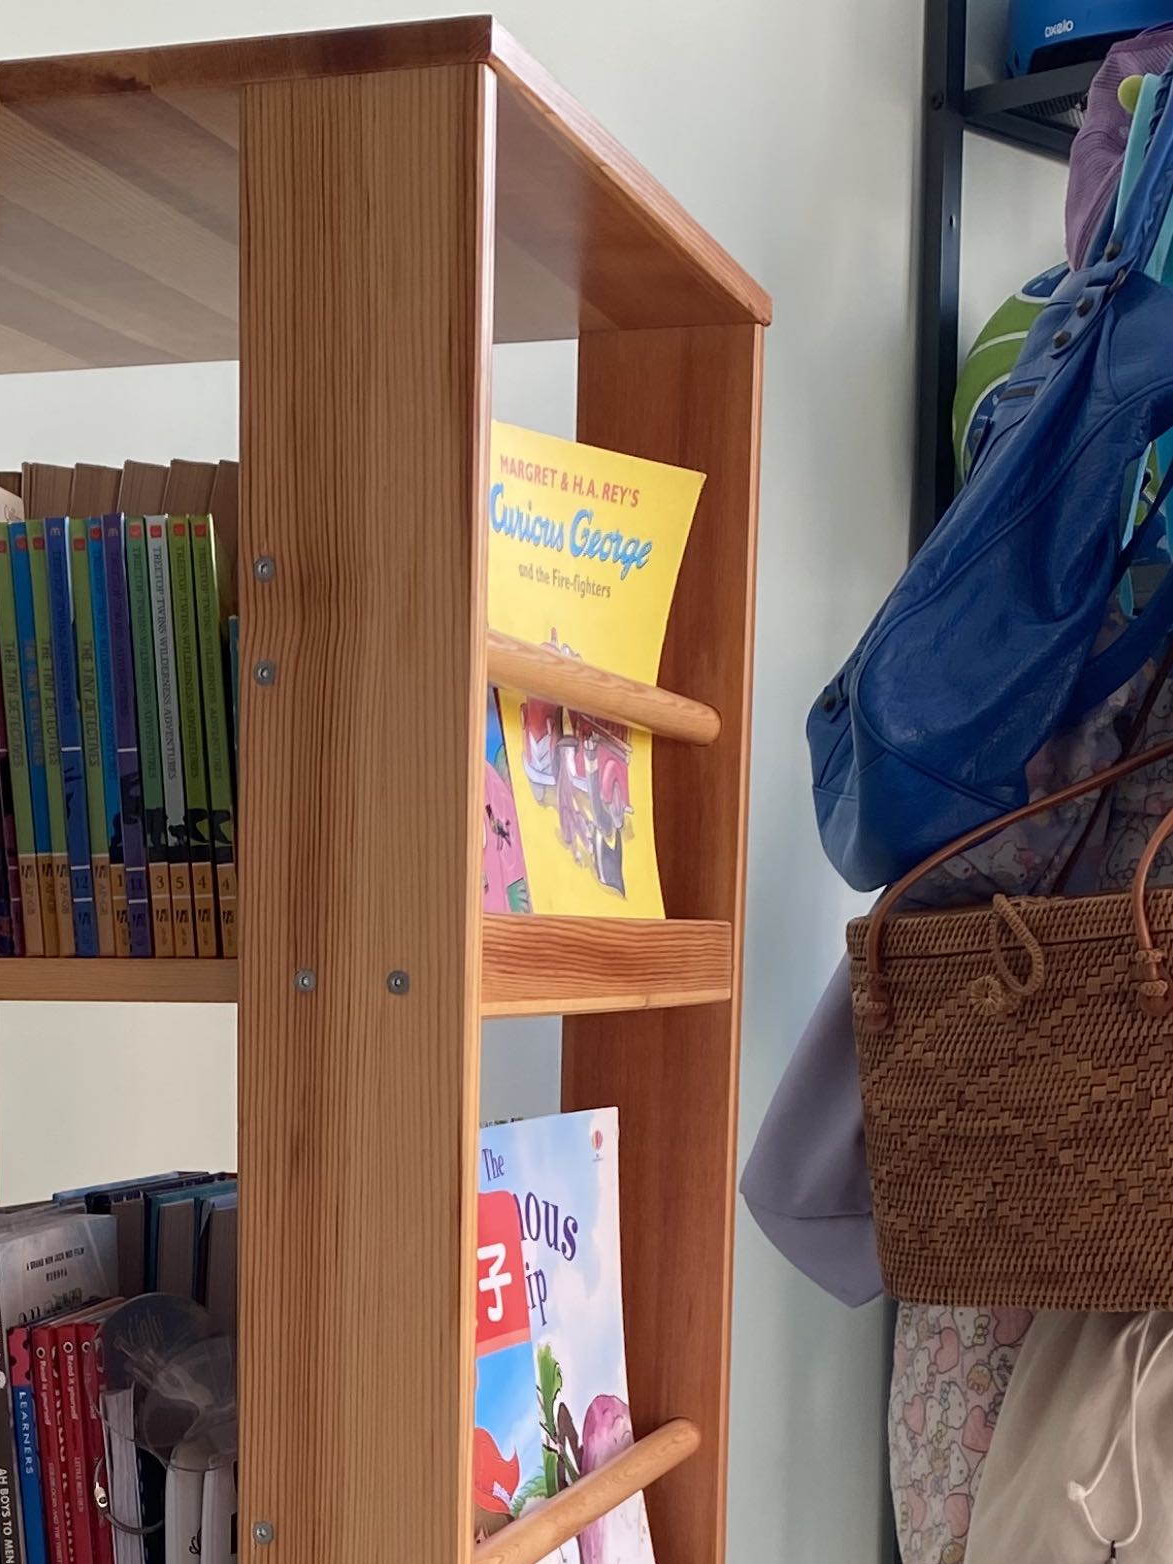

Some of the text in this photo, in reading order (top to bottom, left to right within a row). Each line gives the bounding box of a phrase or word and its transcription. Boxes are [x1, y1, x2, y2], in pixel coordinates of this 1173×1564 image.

[1044, 19, 1074, 38] oxelo
[500, 454, 641, 508] MARGRET & H.A. REY'S
[489, 482, 653, 581] Curious George
[518, 562, 612, 599] and the Fire-fighters
[151, 546, 177, 780] TREETOP TWINS WILDERNESS ADVENTURES
[4, 642, 23, 769] THE TINY DETECTIVES
[83, 640, 100, 768] THE TINY DETECTIVES
[156, 876, 165, 889] 3
[175, 877, 184, 890] 5
[197, 876, 206, 889] 4
[481, 1148, 505, 1182] The
[18, 1391, 34, 1474] LEARNERS
[0, 1488, 12, 1516] BOYS
[1, 1520, 13, 1535] TO
[3, 1538, 15, 1564] MEN
